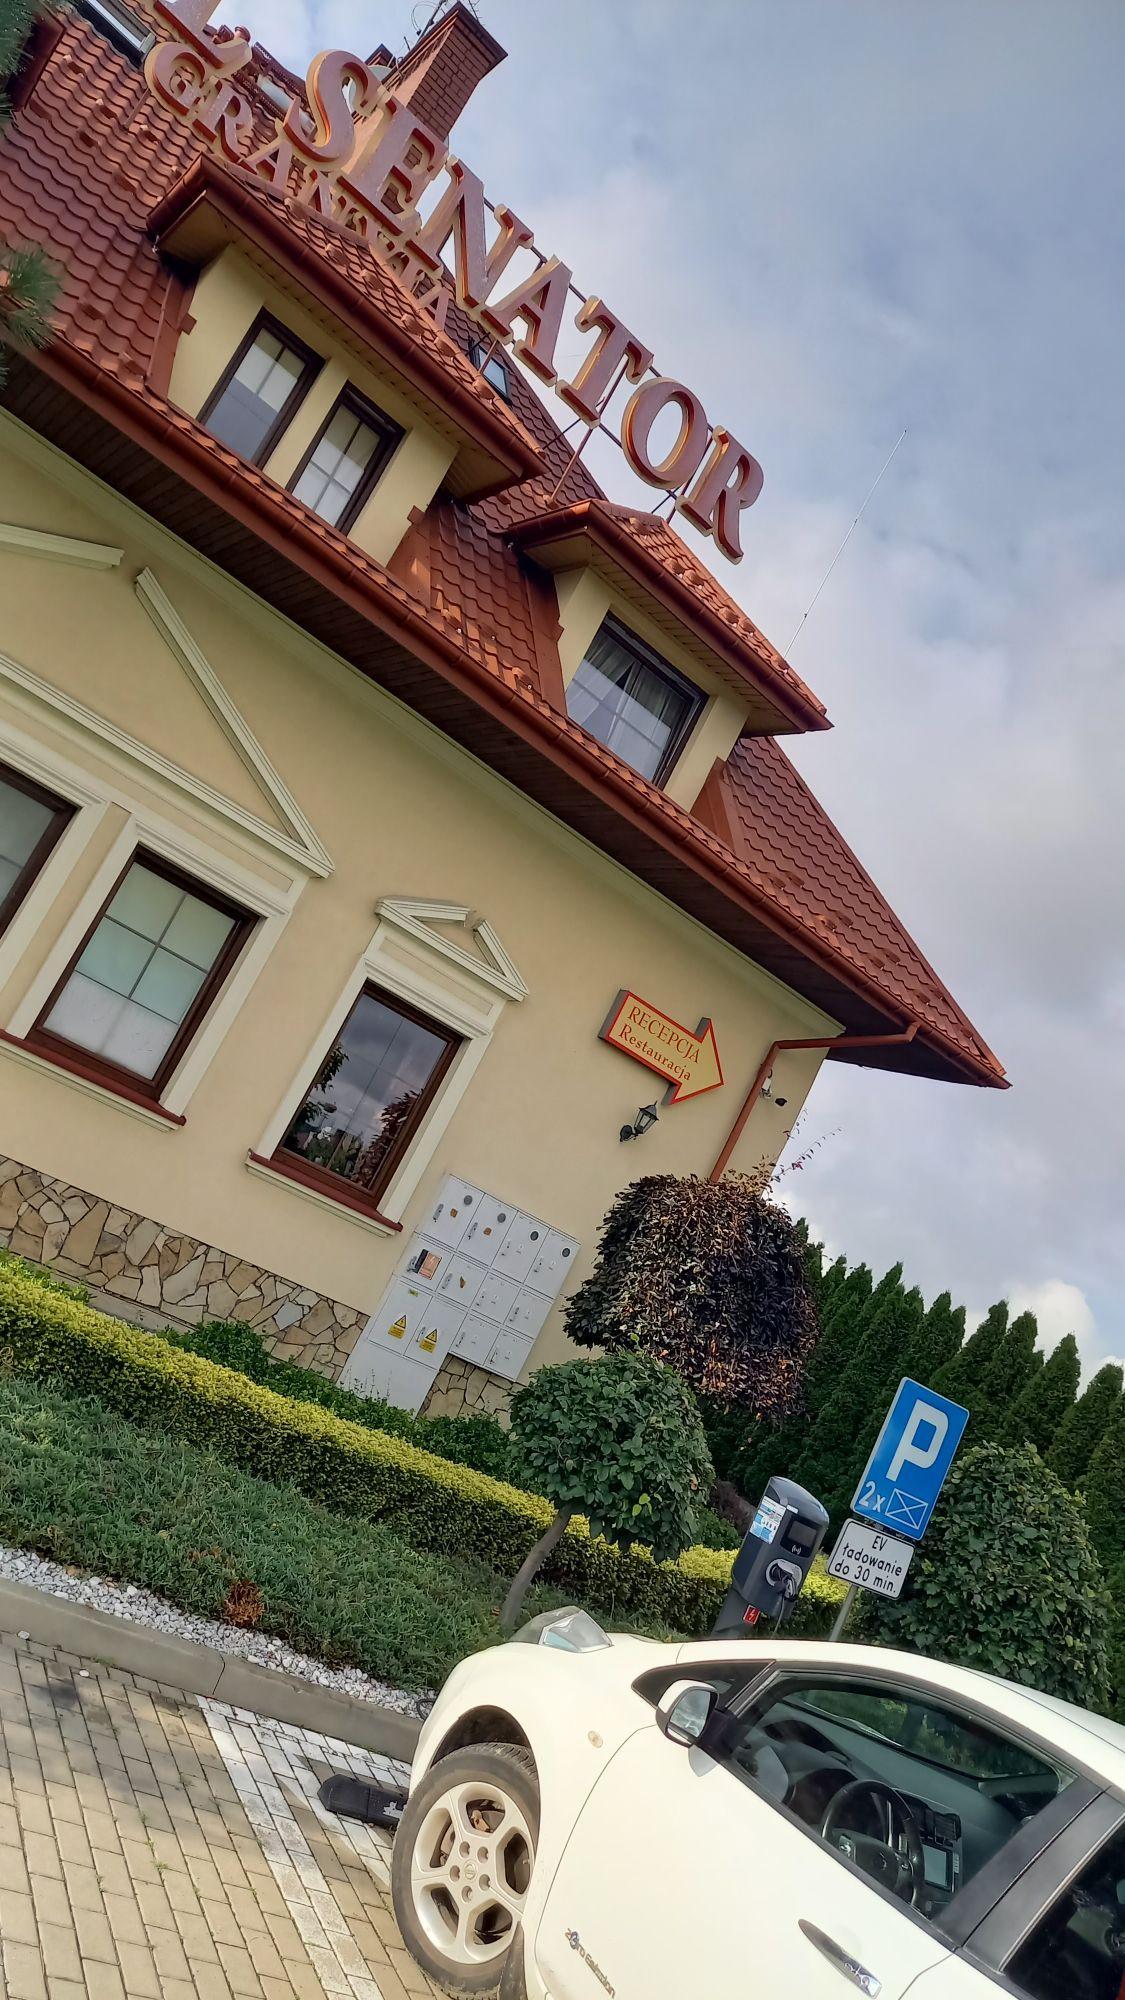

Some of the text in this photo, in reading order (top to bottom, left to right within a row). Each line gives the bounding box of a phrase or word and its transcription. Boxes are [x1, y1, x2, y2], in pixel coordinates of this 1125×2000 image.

[284, 49, 764, 565] SENATOR
[618, 1023, 691, 1081] Restauracja
[627, 1006, 701, 1064] RECEPCJA
[886, 1399, 949, 1482] P
[842, 1543, 903, 1577] ładowanie
[872, 1535, 888, 1551] EV
[834, 1559, 897, 1593] do 30 min.
